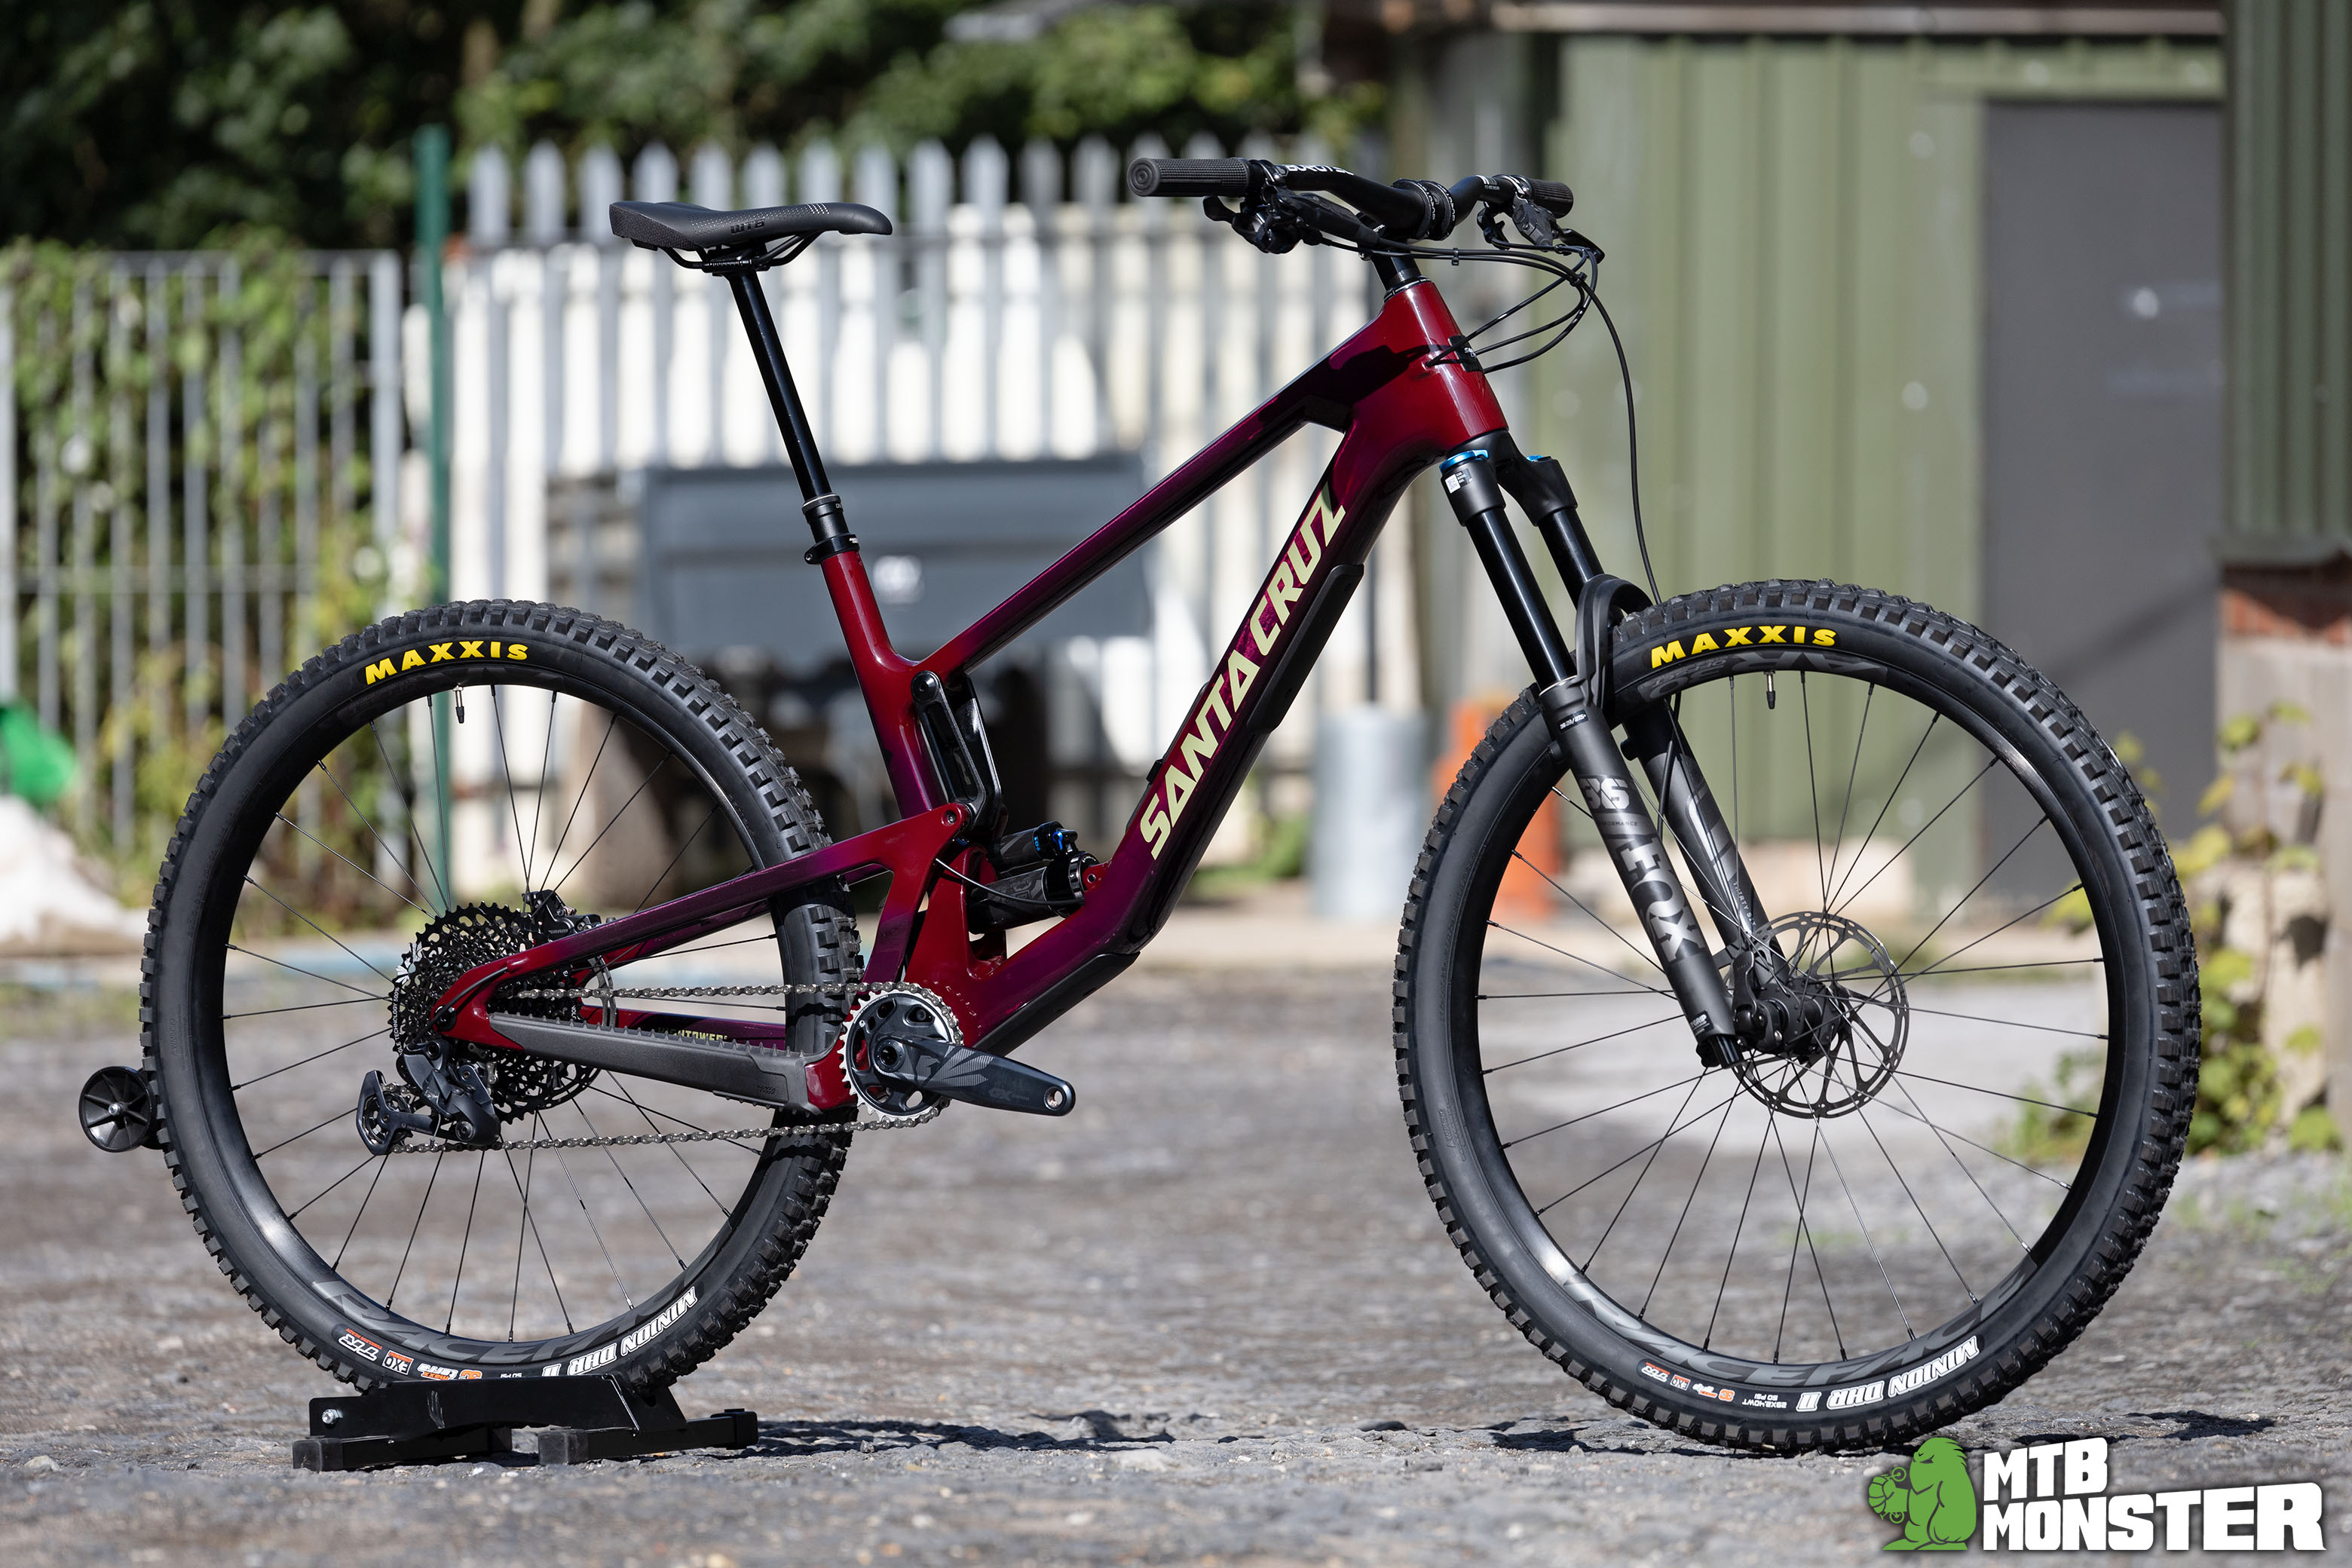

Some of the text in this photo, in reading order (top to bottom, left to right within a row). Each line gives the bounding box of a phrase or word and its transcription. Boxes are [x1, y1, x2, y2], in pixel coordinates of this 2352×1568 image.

[365, 641, 528, 685] MAXXIS
[1651, 625, 1836, 669] MAXXIS
[1140, 481, 1346, 860] SANTA CRUZ
[1579, 778, 1630, 810] 36
[1619, 836, 1707, 963] FOX
[621, 1286, 698, 1356] MINION
[338, 1333, 378, 1361] TR
[384, 1357, 408, 1374] EXO
[567, 1342, 617, 1376] DHR
[1671, 1379, 1689, 1390] EXO
[1796, 1335, 1980, 1413] MINION DHR II
